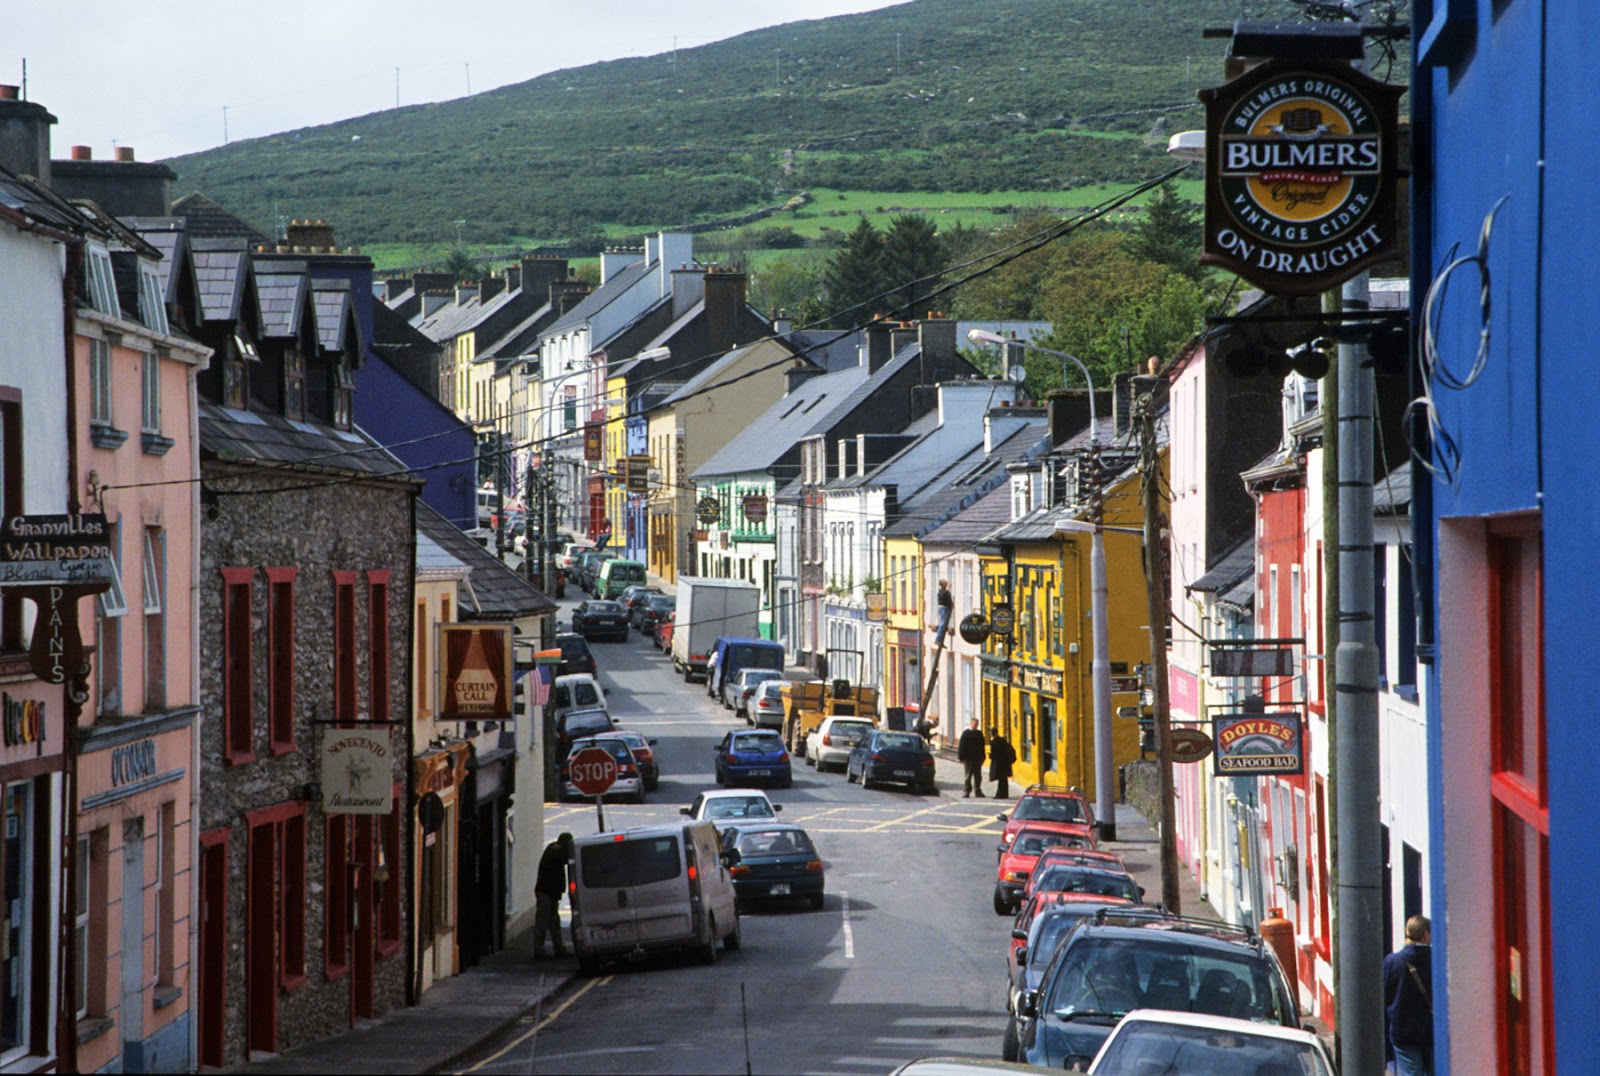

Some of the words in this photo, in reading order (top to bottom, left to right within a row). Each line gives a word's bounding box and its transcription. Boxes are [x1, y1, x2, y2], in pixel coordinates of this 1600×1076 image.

[1234, 81, 1297, 128] BULMERS
[1304, 80, 1368, 126] ORIGINAL
[1227, 141, 1377, 169] BULMERS
[1272, 181, 1331, 210] Original
[1234, 193, 1308, 240] VINTAGE
[1320, 193, 1368, 236] CIDER
[1217, 229, 1255, 260] ON
[1257, 224, 1382, 273] DRAUGHT
[6, 542, 110, 562] Wallpaper
[4, 565, 53, 580] Blind
[49, 586, 65, 683] PAINTS
[455, 682, 495, 692] CURTAIN
[464, 692, 489, 701] CALL
[1222, 722, 1292, 743] DOYLE'S
[327, 737, 386, 757] NOVECENTO
[573, 762, 614, 782] STOP
[1223, 757, 1271, 768] SEAFOOD
[1274, 756, 1295, 767] BAR
[328, 792, 384, 807] Restaurant
